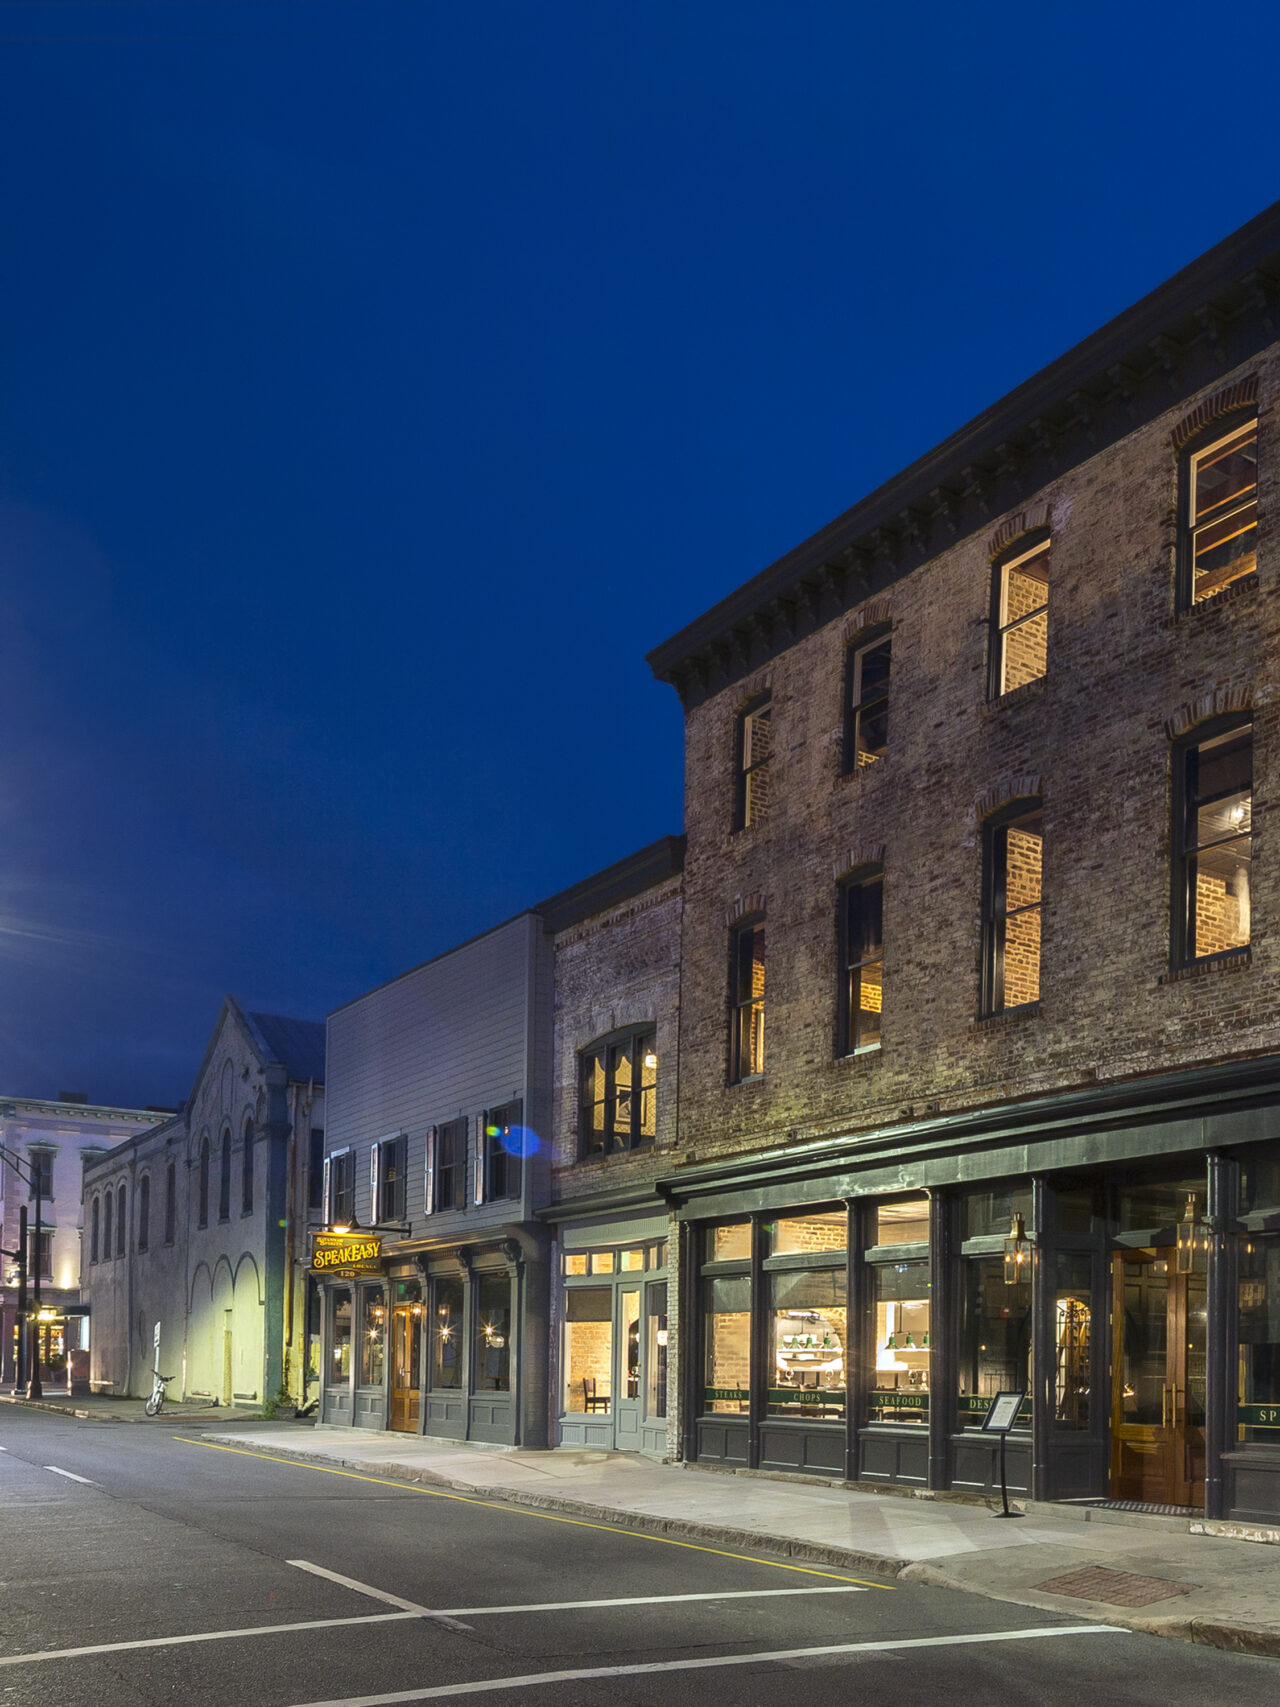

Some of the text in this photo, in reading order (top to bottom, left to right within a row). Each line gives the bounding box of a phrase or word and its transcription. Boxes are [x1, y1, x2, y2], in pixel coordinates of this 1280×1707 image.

[714, 1391, 743, 1399] STEAKS
[793, 1393, 821, 1402] CHOPS
[879, 1395, 922, 1407] SEAFOOD
